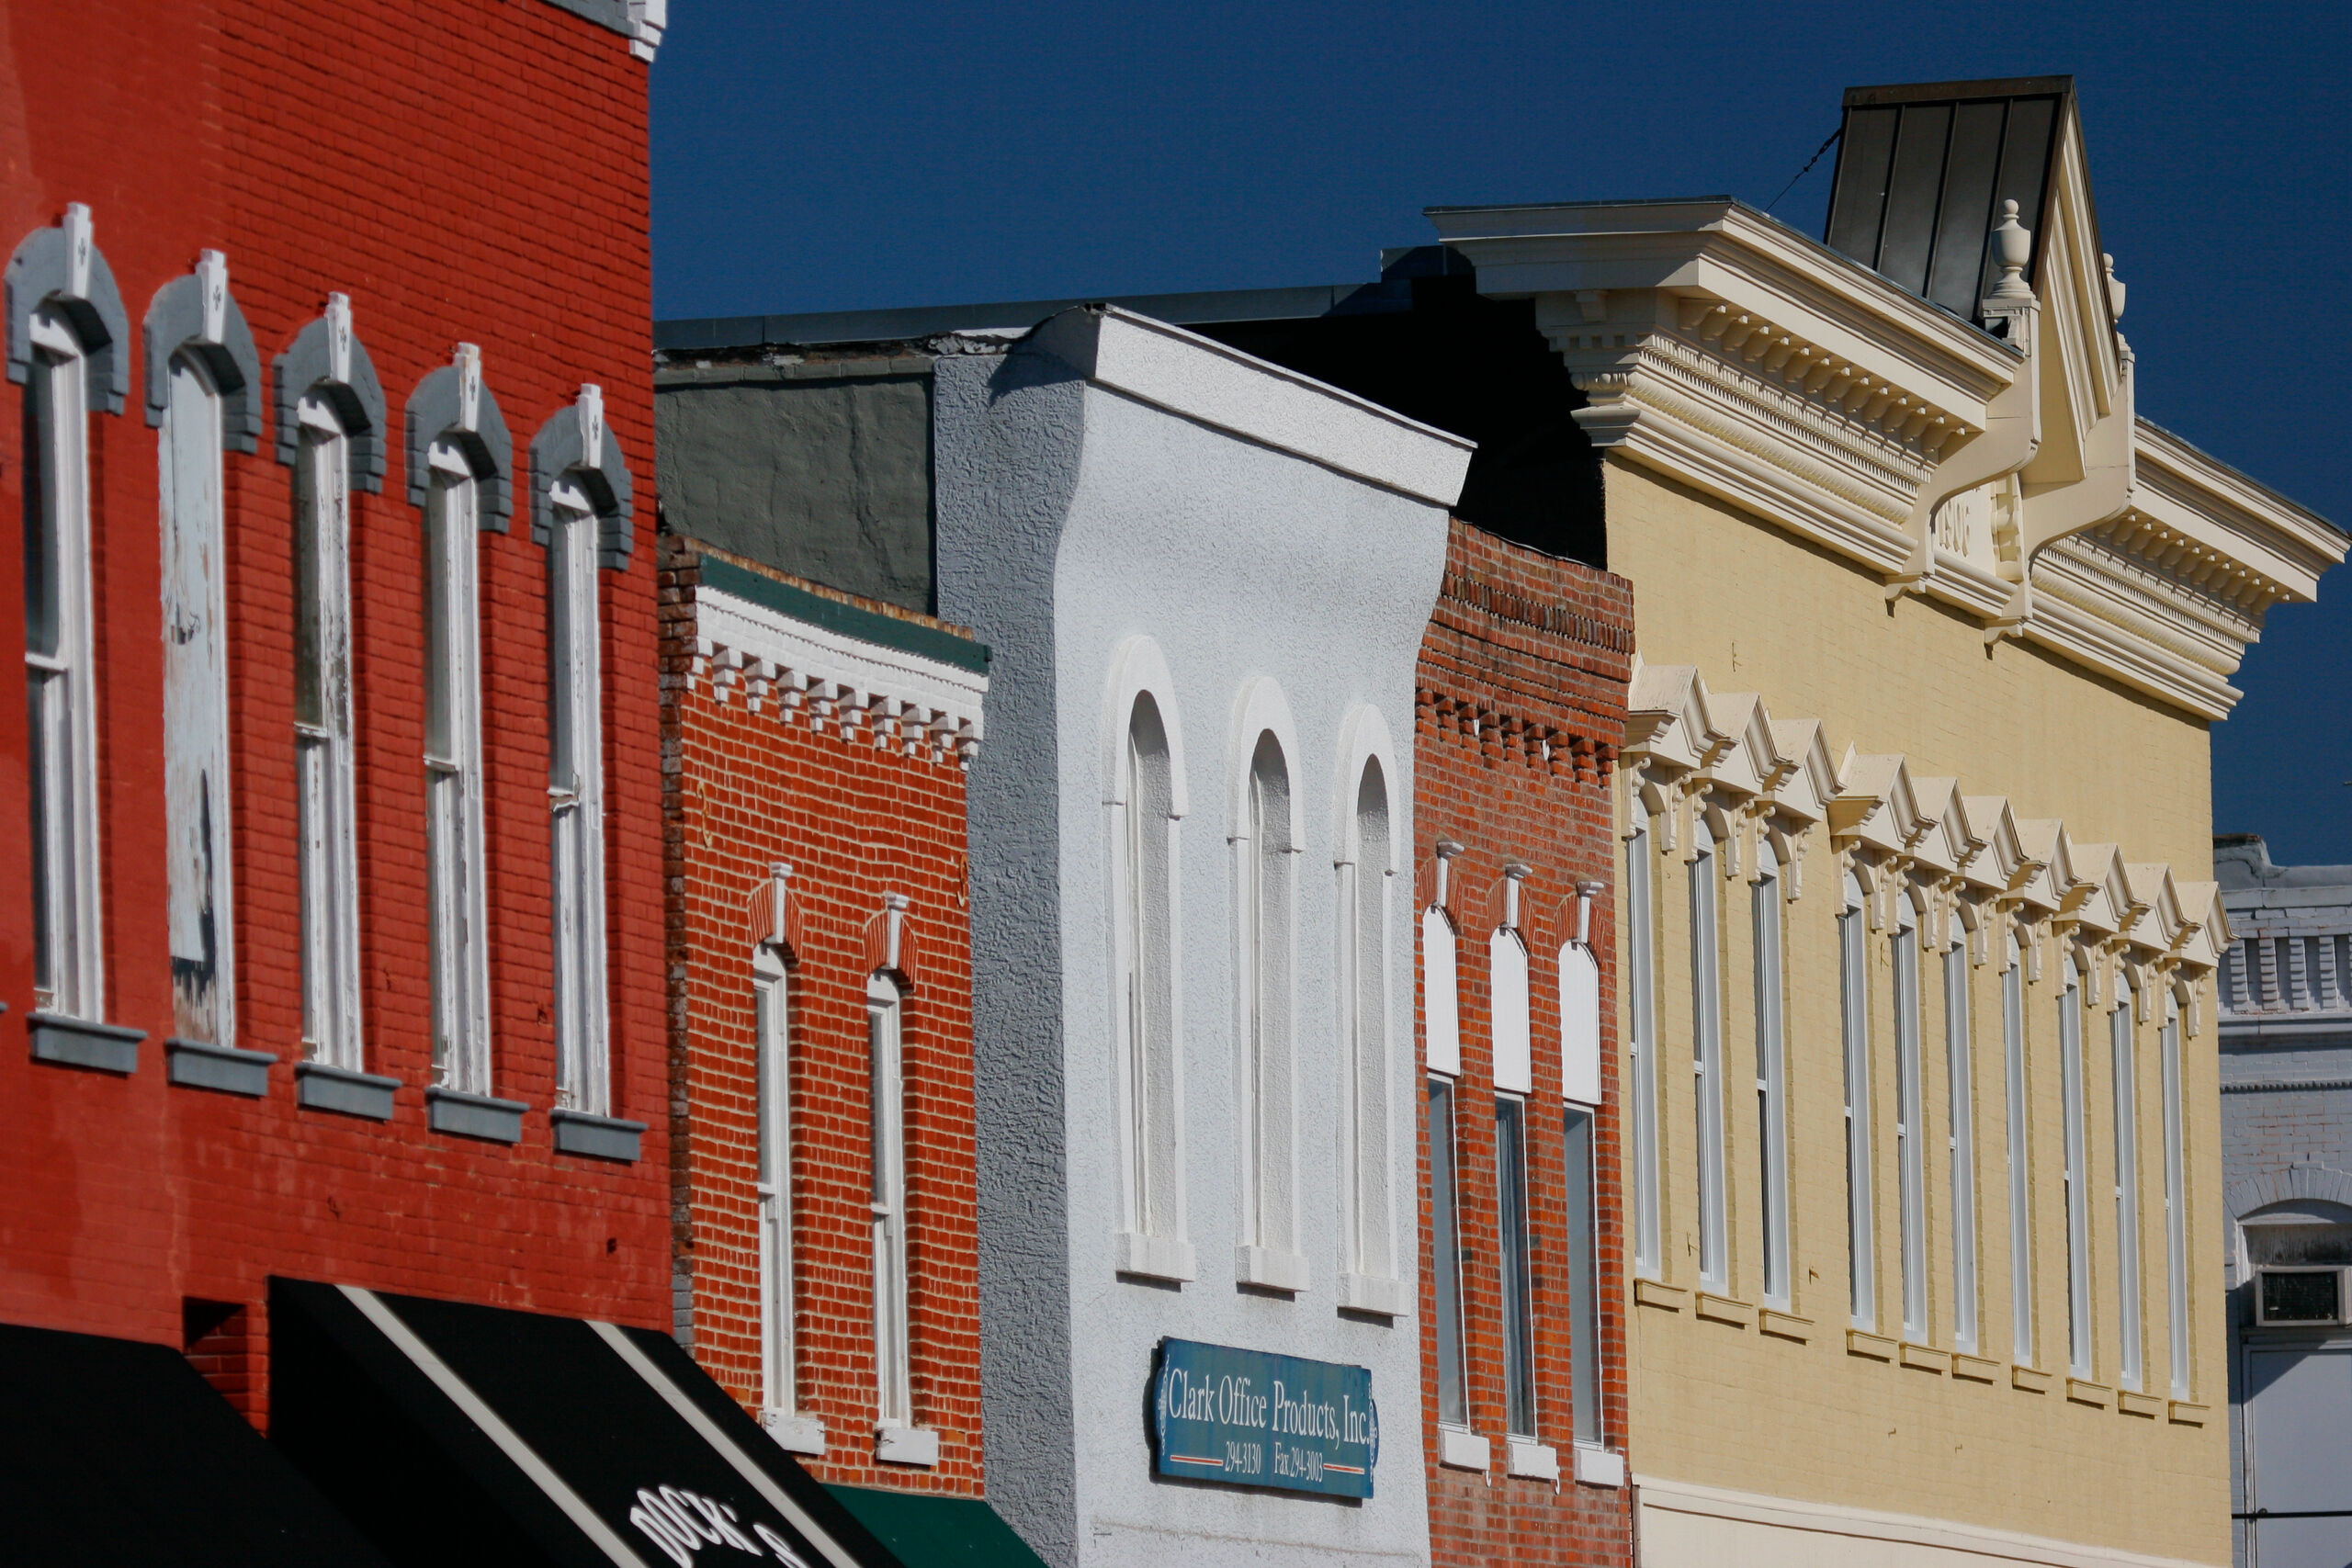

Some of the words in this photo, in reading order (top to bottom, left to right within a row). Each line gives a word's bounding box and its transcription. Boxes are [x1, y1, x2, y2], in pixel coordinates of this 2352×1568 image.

[1169, 1368, 1215, 1422] Clark
[1218, 1374, 1267, 1428] Office
[1272, 1381, 1340, 1450] Products,
[1343, 1394, 1370, 1444] Inc.
[1225, 1440, 1261, 1474] 294-3130
[1274, 1442, 1289, 1477] Fax
